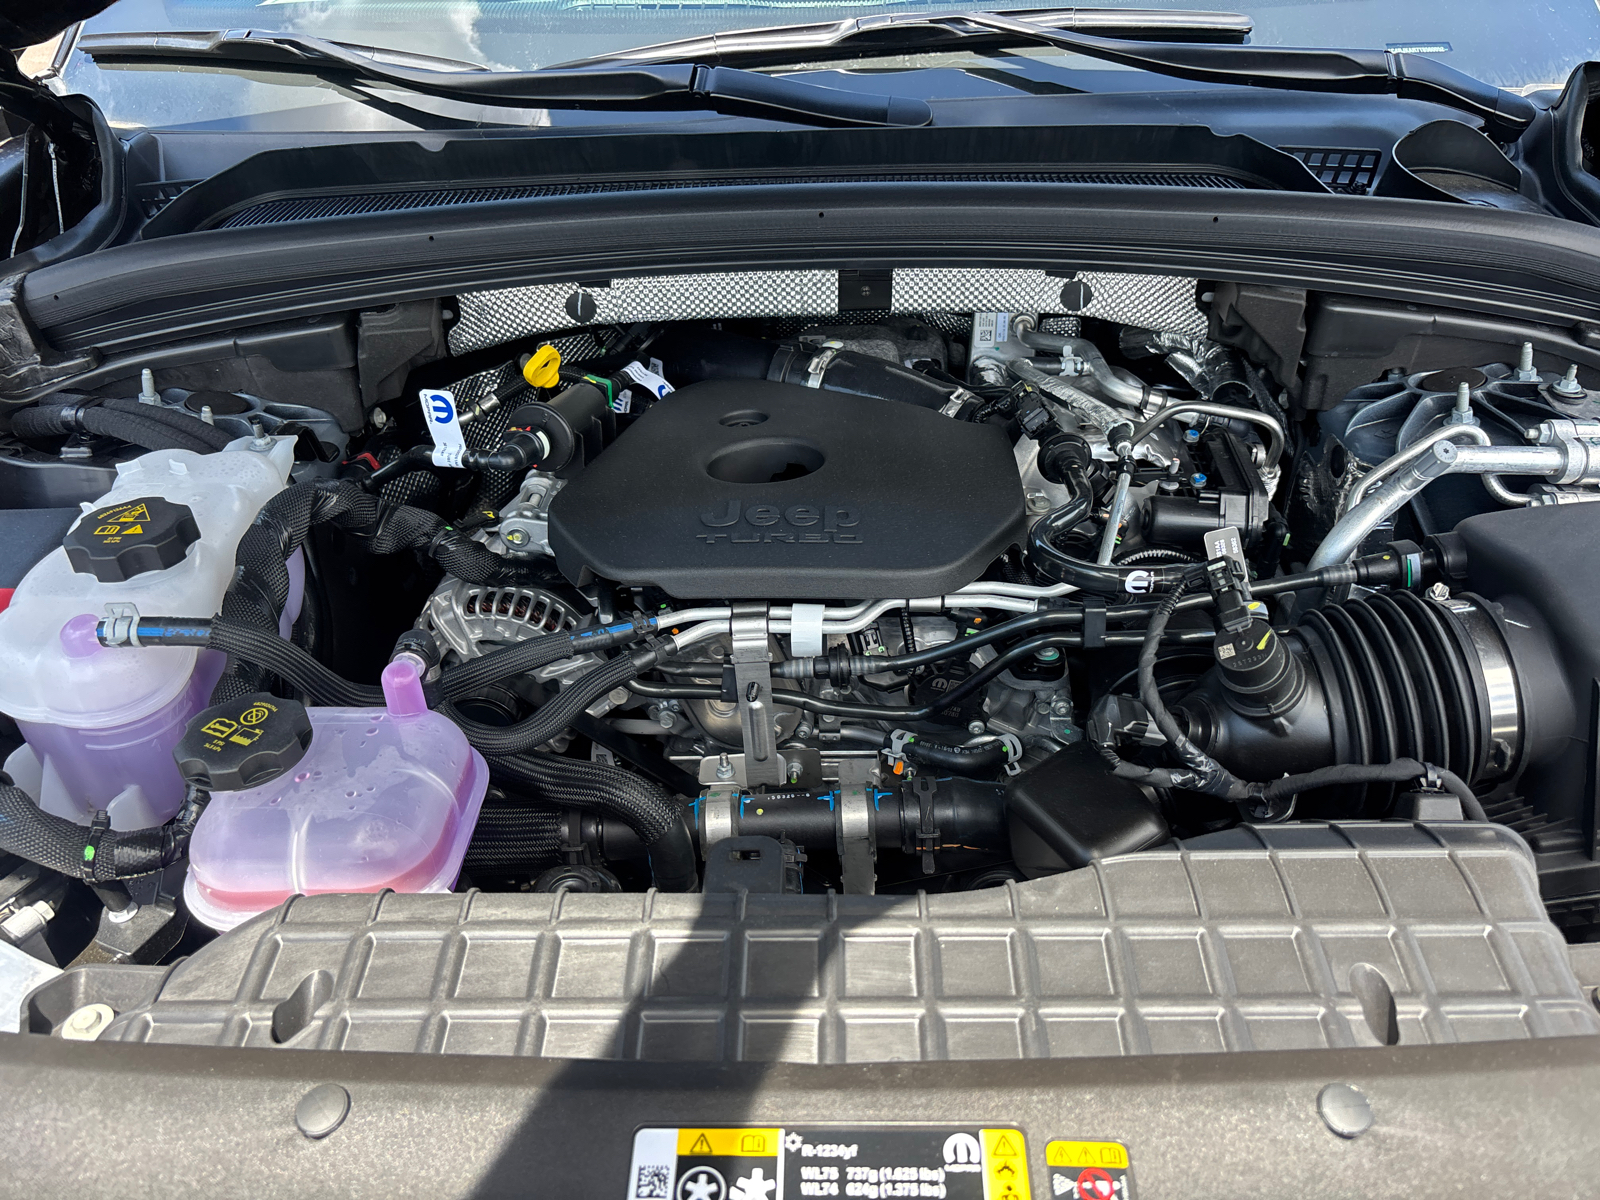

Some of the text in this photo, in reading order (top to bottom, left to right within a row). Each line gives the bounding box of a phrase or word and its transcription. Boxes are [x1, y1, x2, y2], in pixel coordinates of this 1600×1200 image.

[700, 499, 861, 533] Jeep
[695, 533, 863, 544] TURBO
[801, 1144, 858, 1160] R-1234yf
[800, 1166, 839, 1180] WL75
[846, 1166, 879, 1183] 737g
[919, 1167, 946, 1183] lbs)
[800, 1182, 839, 1196] WL74
[846, 1182, 879, 1199] 624g
[919, 1183, 947, 1199] lbs)
